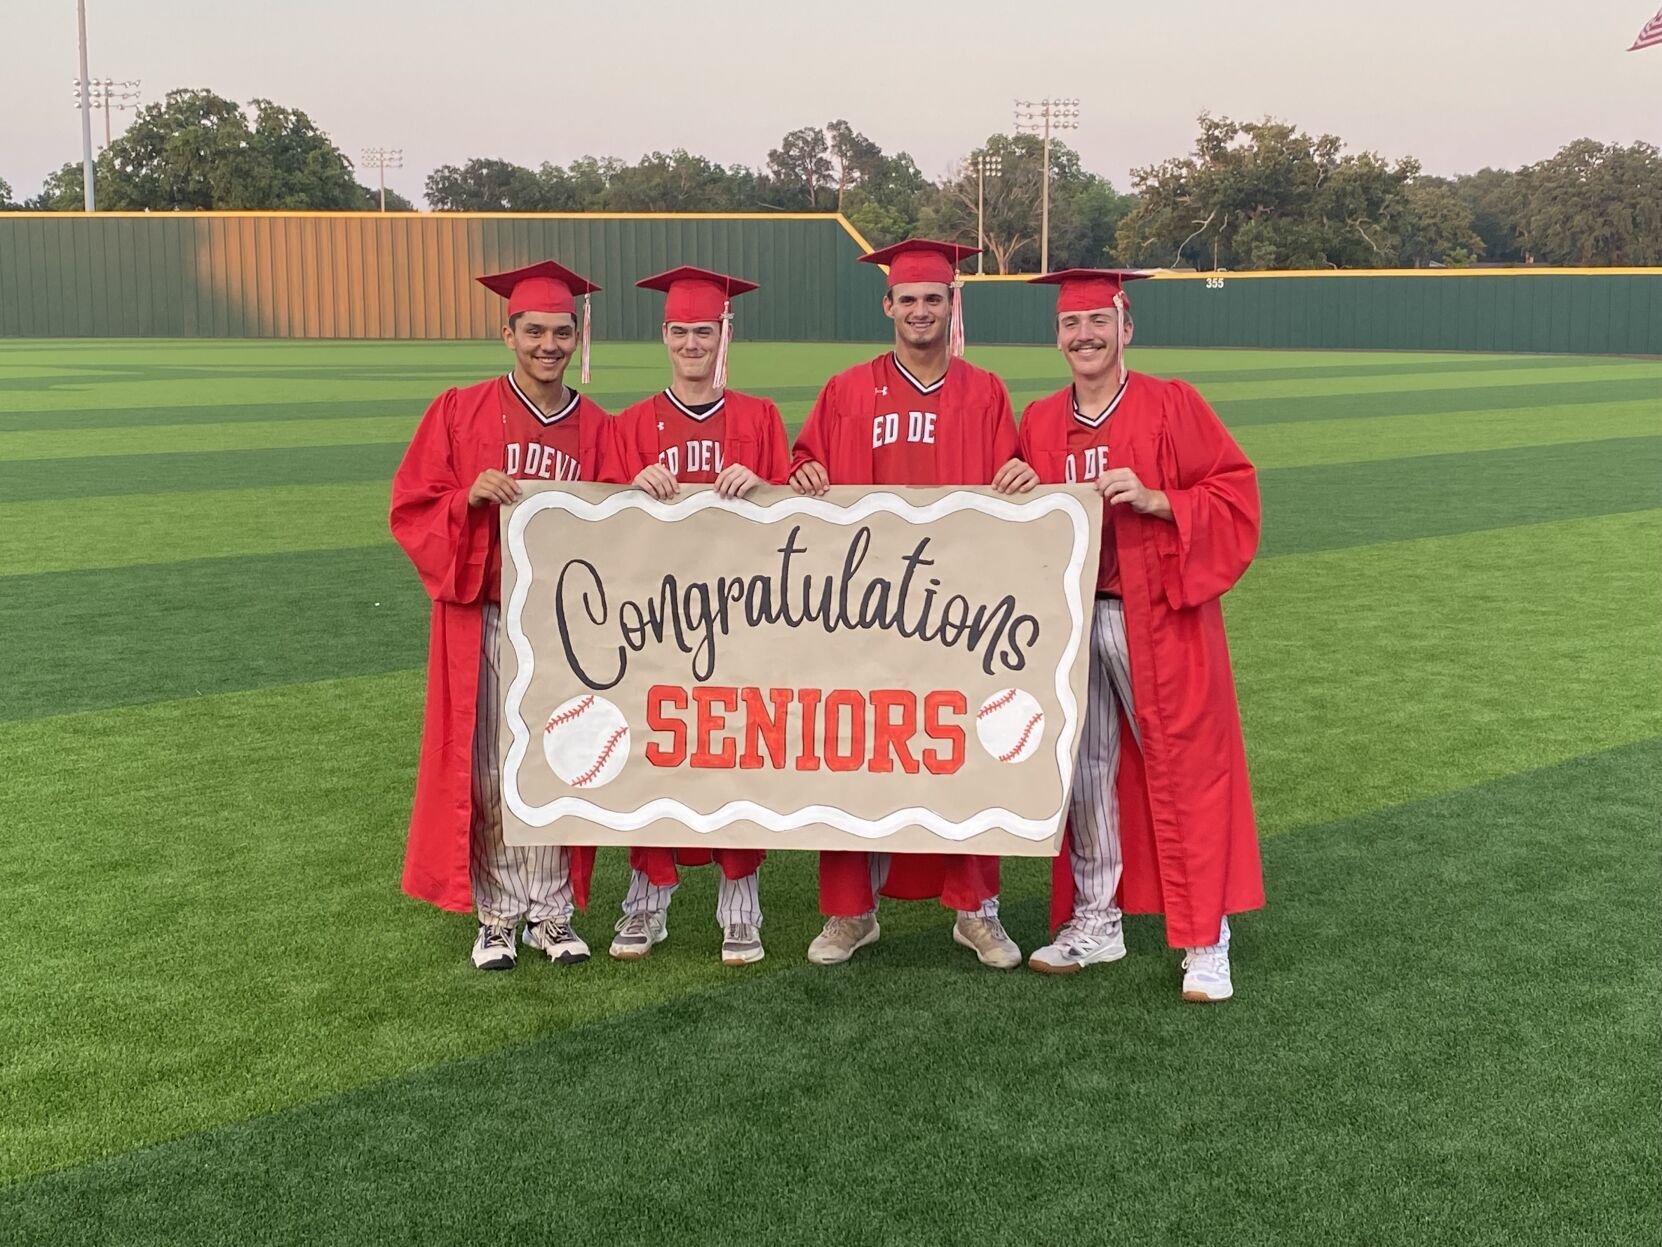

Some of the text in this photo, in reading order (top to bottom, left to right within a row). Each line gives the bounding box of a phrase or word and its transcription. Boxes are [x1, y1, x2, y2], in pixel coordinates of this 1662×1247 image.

[1205, 277, 1224, 289] 355
[872, 411, 937, 449] ED DE
[555, 525, 1040, 691] Congratulations
[645, 684, 968, 775] SENIORS
